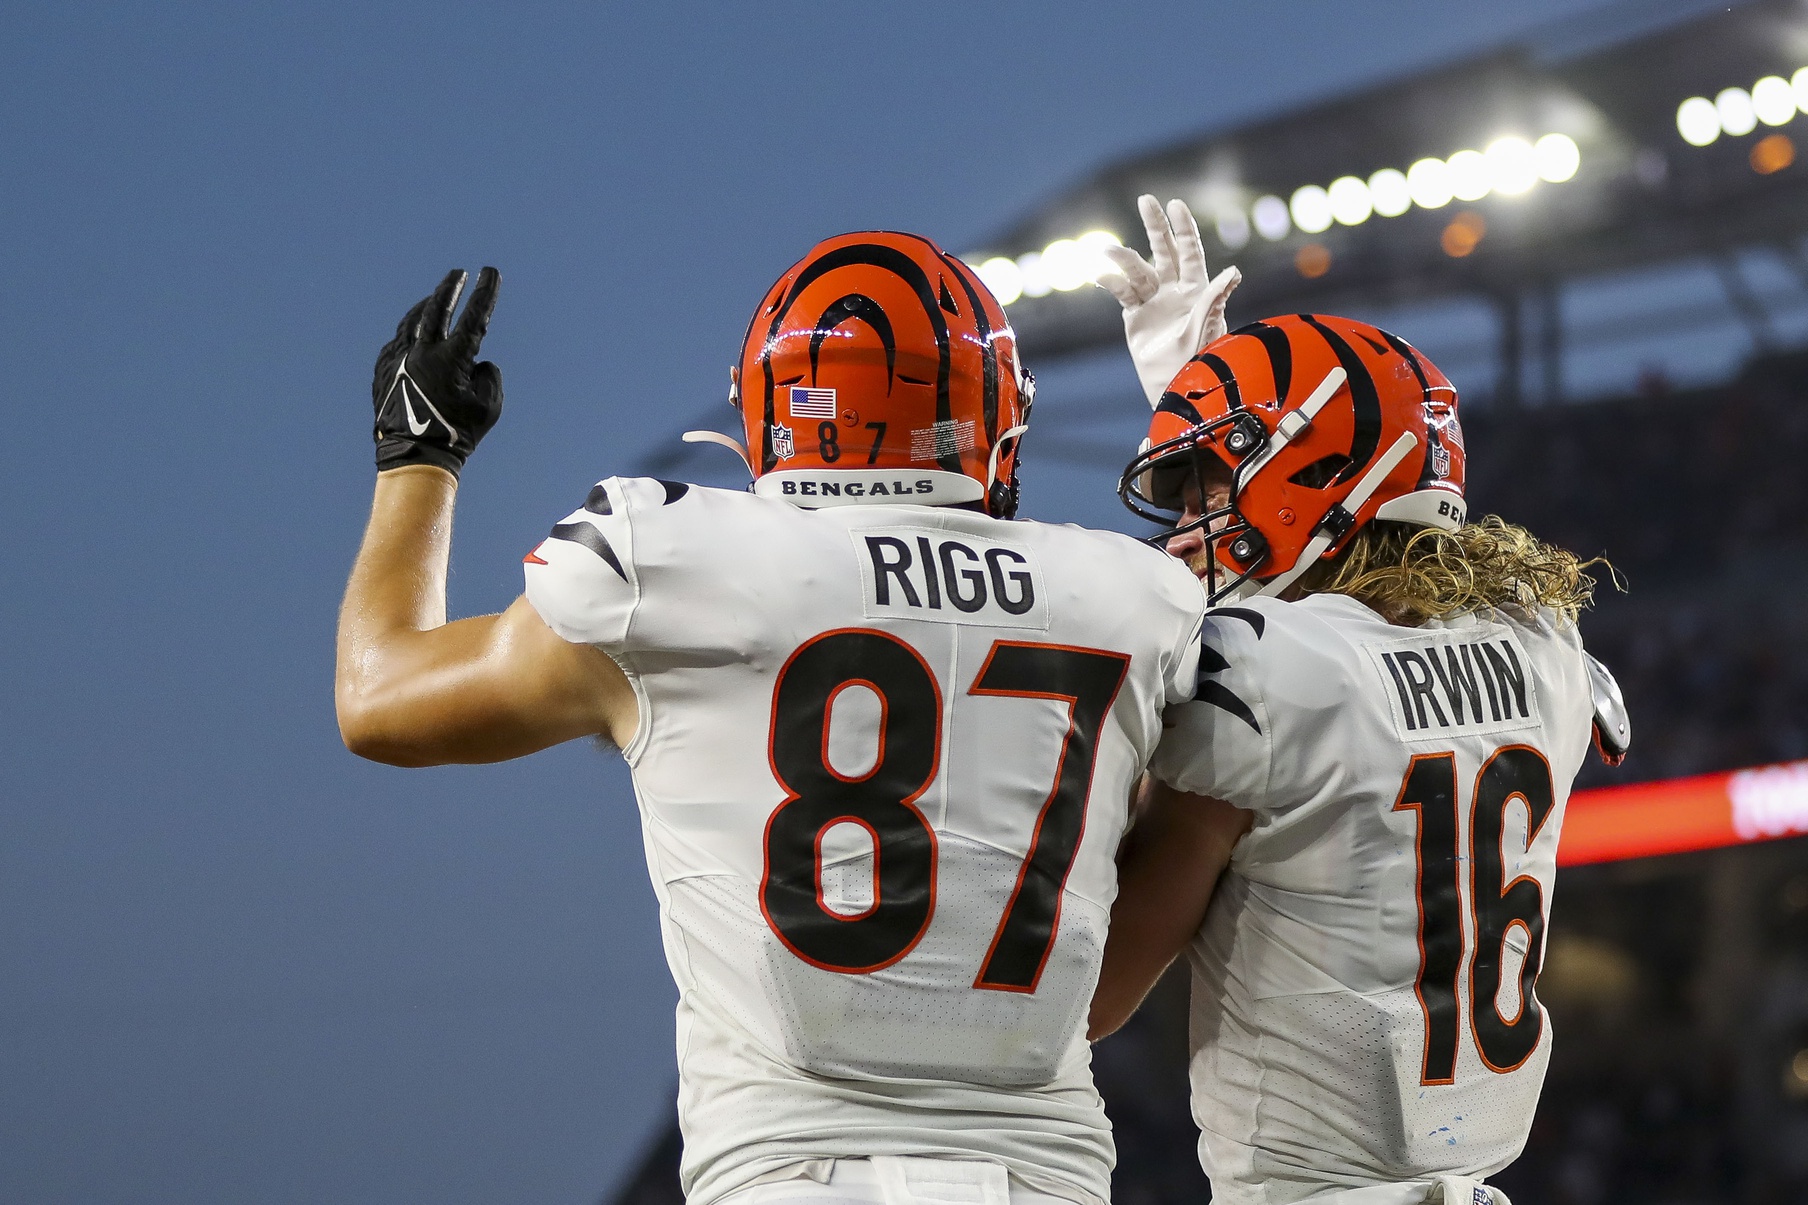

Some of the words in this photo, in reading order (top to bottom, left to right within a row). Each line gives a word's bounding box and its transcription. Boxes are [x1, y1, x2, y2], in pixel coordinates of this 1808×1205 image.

[774, 440, 791, 454] NFL
[932, 418, 959, 428] WARNING
[781, 480, 934, 496] BENGALS
[1434, 458, 1448, 475] NFL
[865, 535, 1035, 615] RIGG
[1382, 640, 1529, 731] IRWIN
[758, 627, 1132, 994] 87
[1393, 743, 1555, 1086] 16
